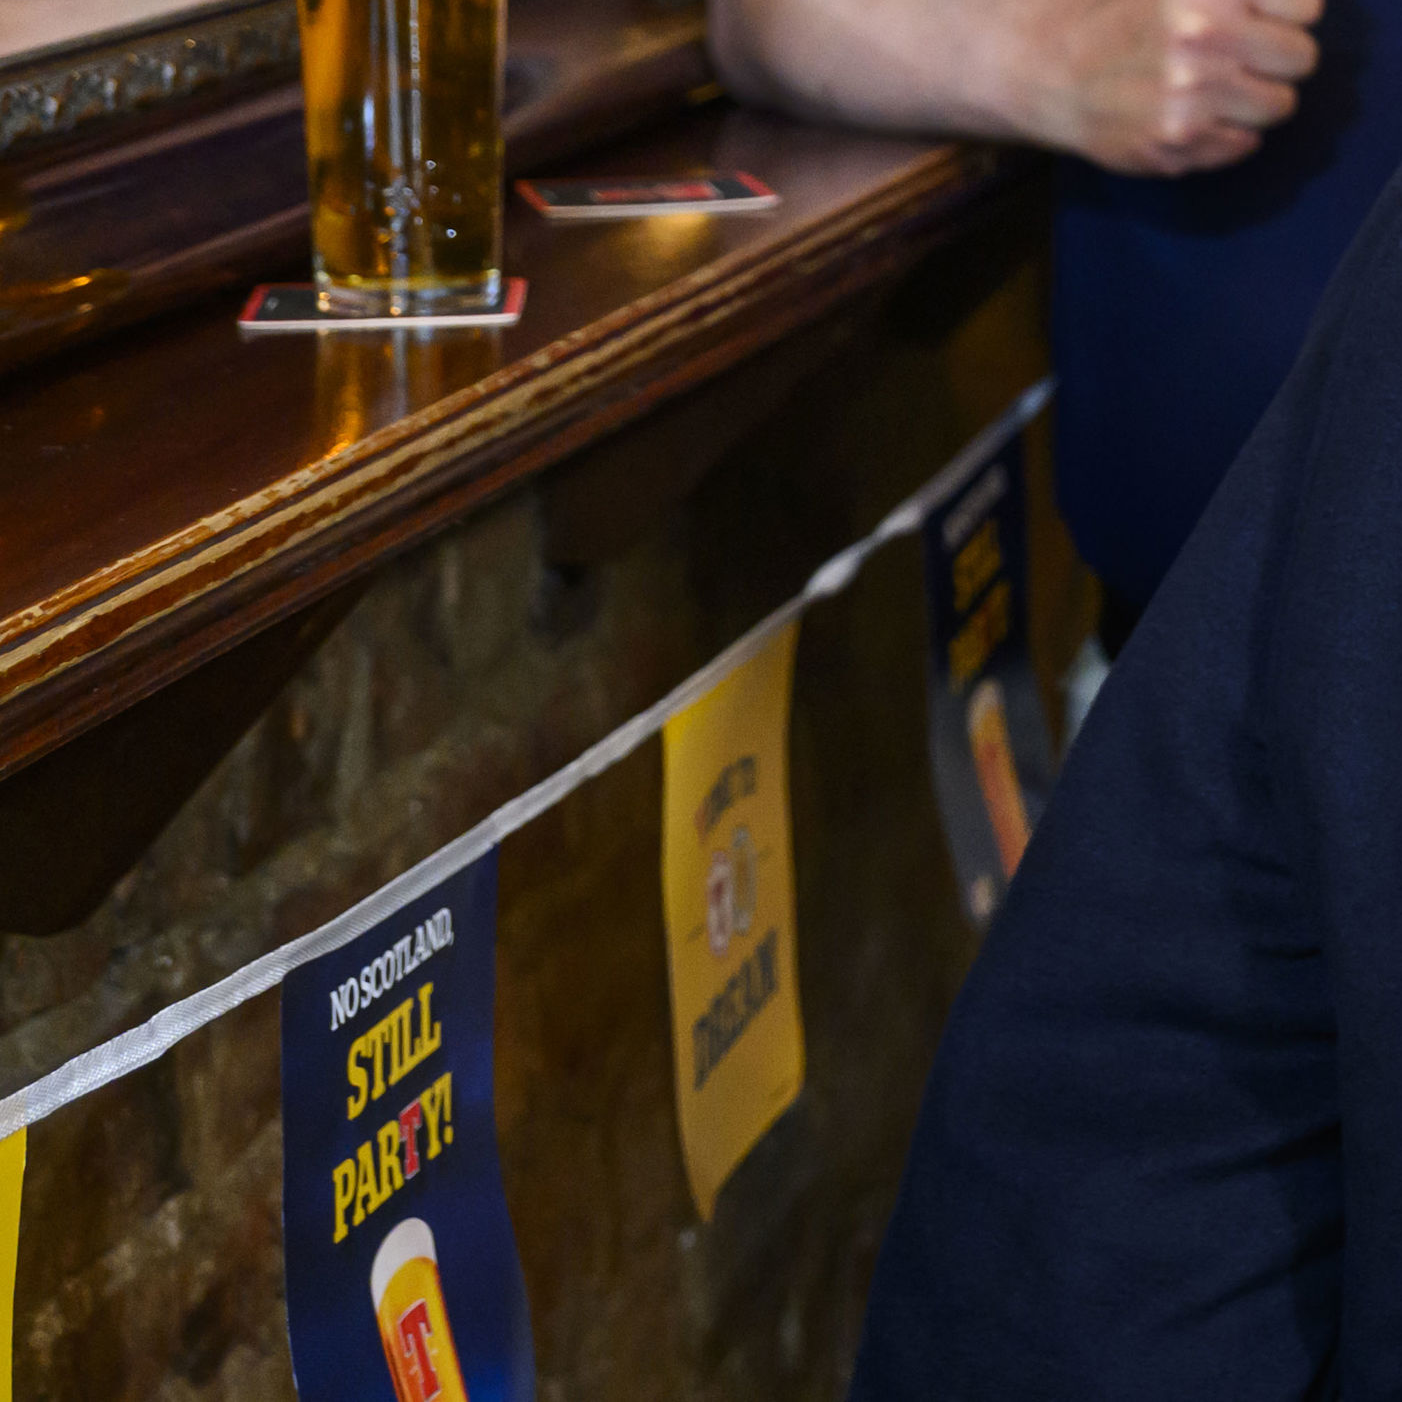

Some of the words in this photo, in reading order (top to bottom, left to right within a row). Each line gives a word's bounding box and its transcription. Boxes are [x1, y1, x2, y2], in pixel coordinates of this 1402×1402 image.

[330, 977, 360, 1031] NO
[346, 981, 442, 1121] STILL
[332, 1071, 454, 1245] PARTY!
